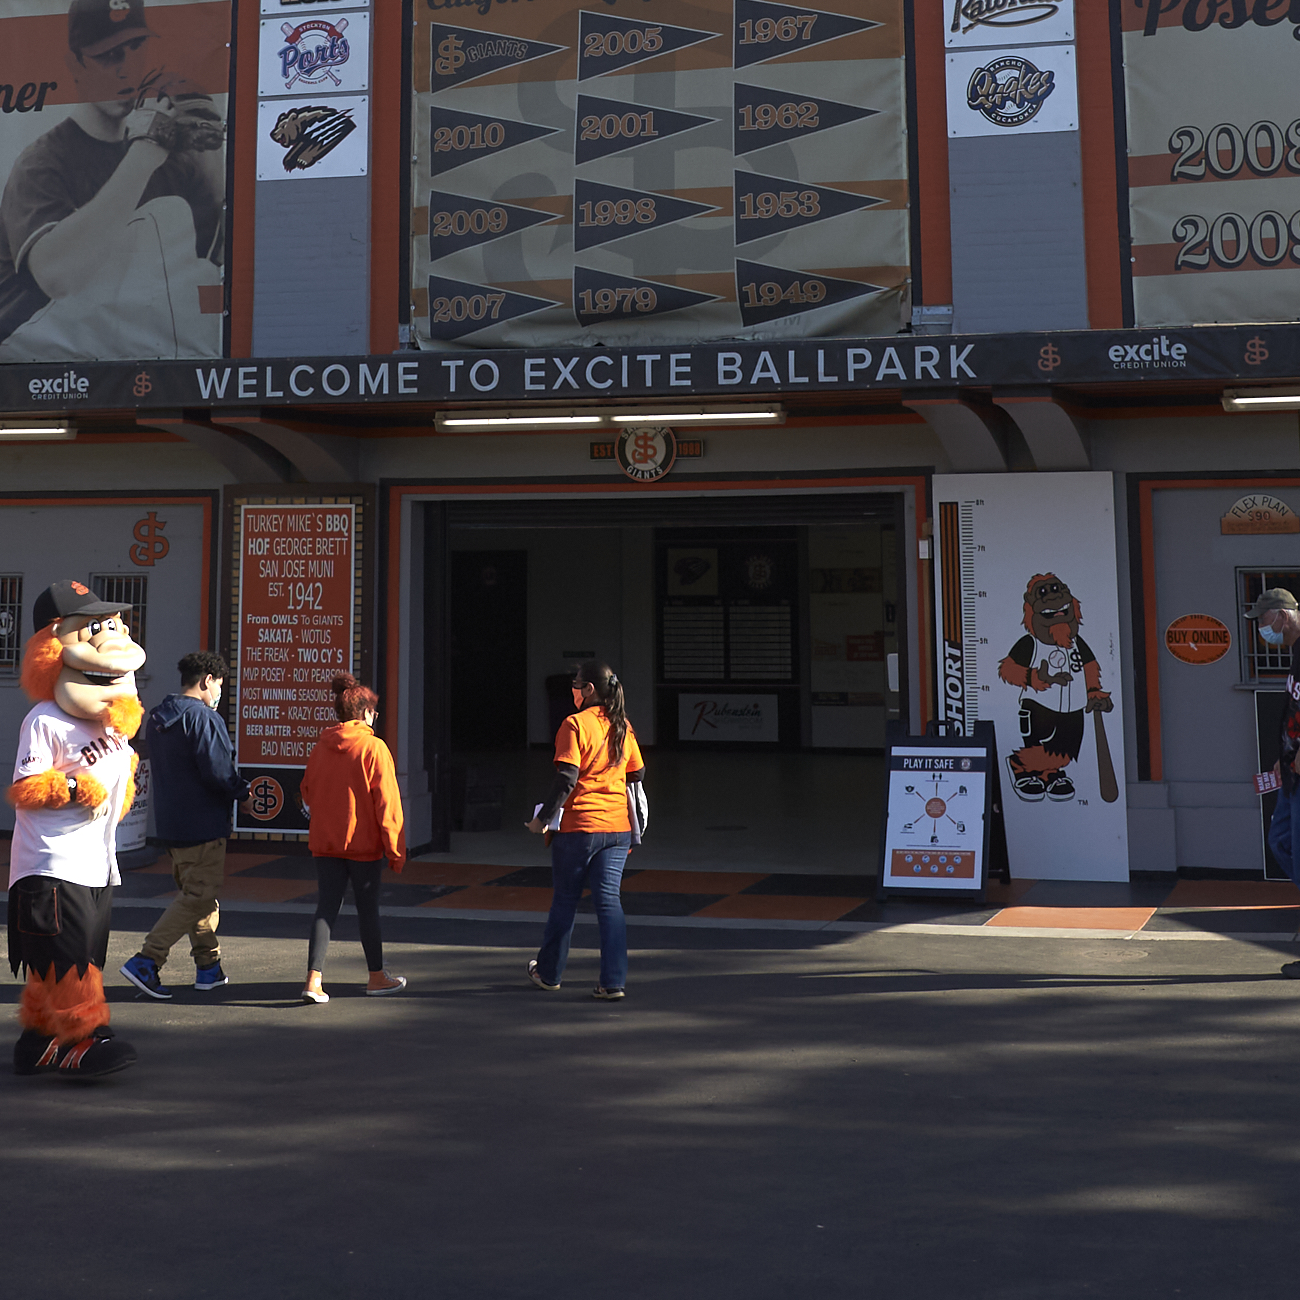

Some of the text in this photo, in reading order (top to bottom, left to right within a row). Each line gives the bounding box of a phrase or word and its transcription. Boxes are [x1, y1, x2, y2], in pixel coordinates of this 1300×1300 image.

[738, 14, 818, 44] 1967
[467, 39, 529, 62] GIANTS
[584, 26, 663, 57] 2005
[580, 111, 659, 141] 2001
[738, 101, 819, 130] 1962
[434, 122, 505, 153] 2010
[578, 198, 657, 228] 1998
[739, 190, 821, 219] 1953
[433, 207, 508, 238] 2009
[578, 286, 658, 315] 1979
[742, 280, 827, 308] 1949
[433, 292, 506, 323] 2007
[1108, 335, 1188, 362] excite
[195, 345, 977, 400] WELCOME TO EXCITE BALLPARK
[1113, 360, 1187, 370] CREDIT UNION
[29, 370, 89, 394] excite
[626, 466, 663, 479] GIANTS
[1231, 496, 1289, 518] FLEX PLAN
[1248, 510, 1271, 522] $90
[247, 514, 349, 536] TURKEY BBQ
[248, 537, 348, 556] HOF GEORGE BRETT
[259, 560, 334, 578] SAN JOSE MUNI
[287, 581, 323, 610] 1942
[247, 613, 343, 626] From OWLS To GIANTS
[258, 628, 331, 644] SAKATA WOTUS
[1167, 629, 1228, 644] BUY ONLINE
[246, 647, 318, 663] THE FREAK TWO
[243, 667, 286, 682] MVP POSEY
[243, 688, 327, 702] MOST WINNING SEASONS
[242, 705, 313, 720] GIGANTE KRAZY
[246, 724, 318, 738] BEER BATTER SMASH
[261, 741, 304, 757] BAD NEWS
[903, 758, 954, 769] PLAY IT SAFE
